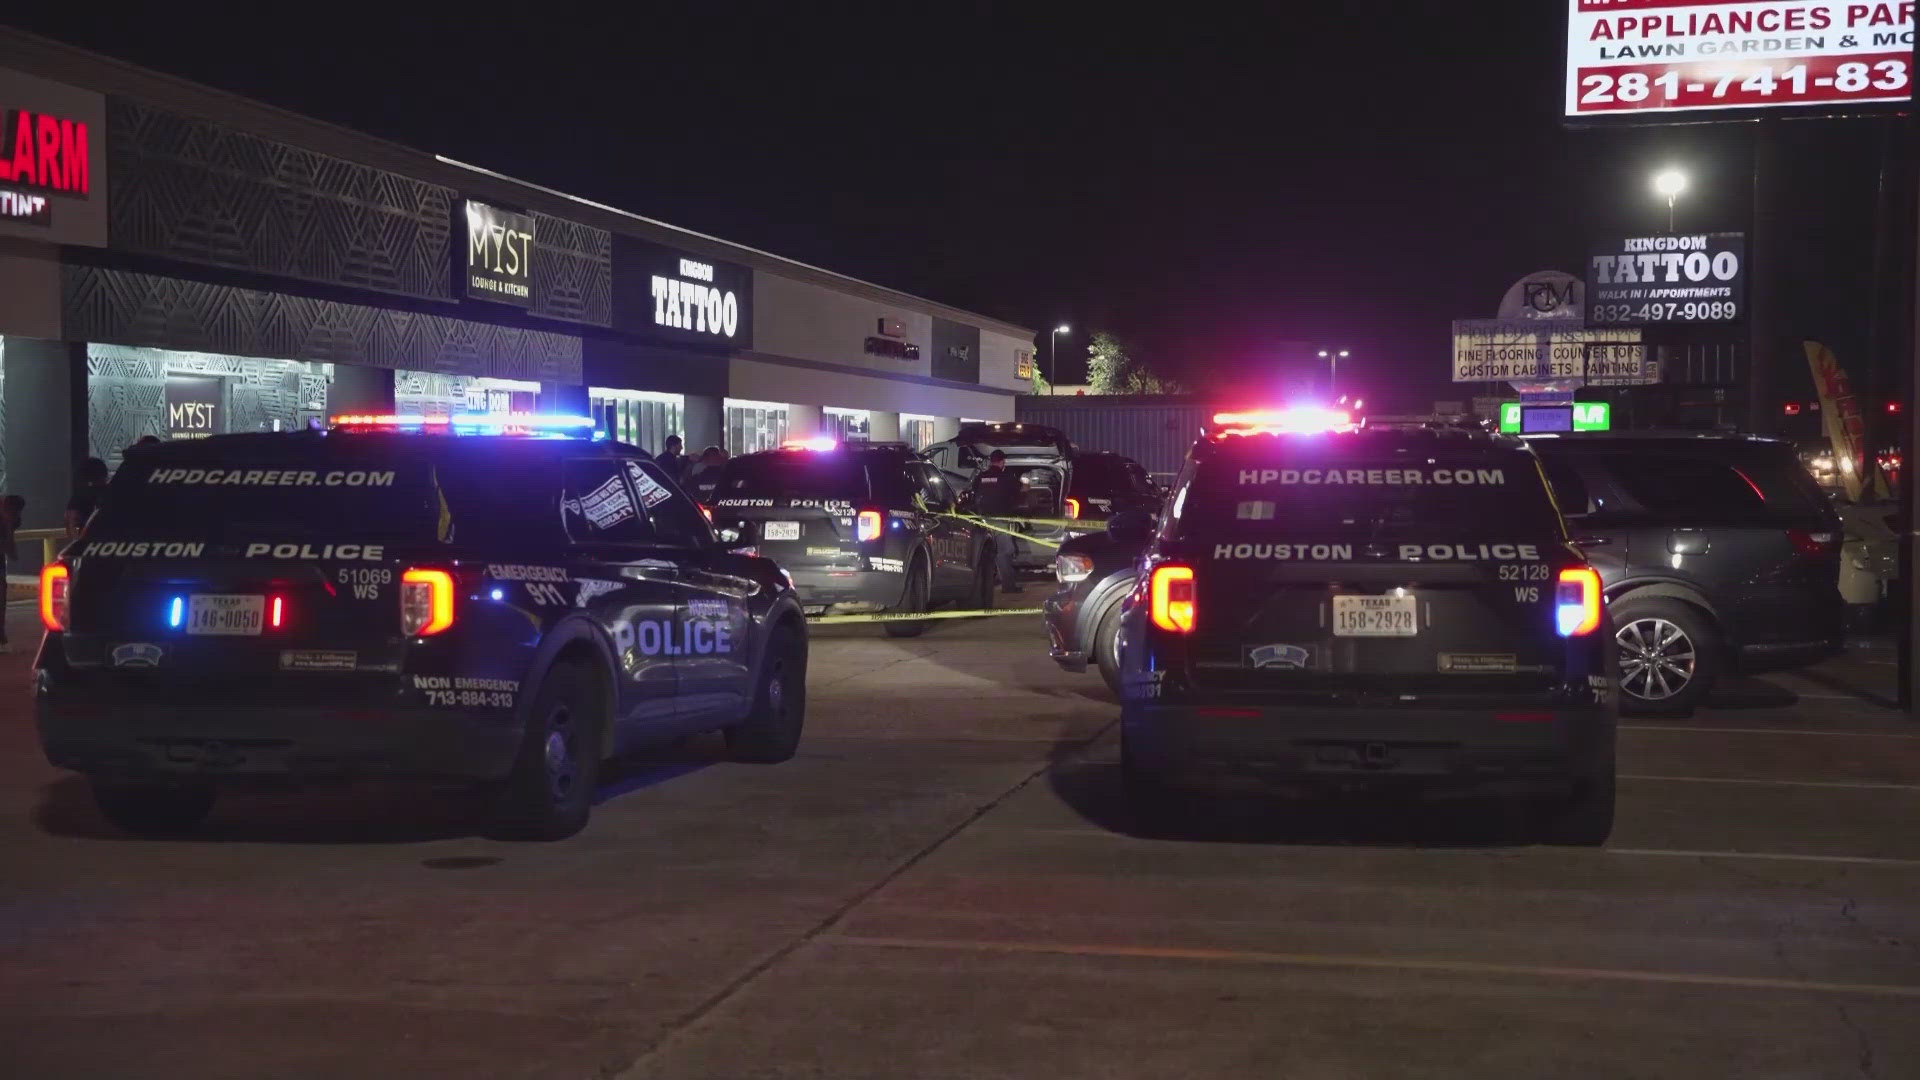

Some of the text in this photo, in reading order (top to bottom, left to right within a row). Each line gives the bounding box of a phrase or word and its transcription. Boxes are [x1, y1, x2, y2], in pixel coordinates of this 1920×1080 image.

[1589, 7, 1832, 41] APPLIANCES
[1600, 43, 1685, 60] LAWN
[1697, 36, 1825, 55] GARDEN
[1838, 34, 1859, 48] &
[0, 190, 46, 216] TINT
[469, 221, 533, 278] MYST
[1623, 235, 1707, 252] KINGDOM
[679, 258, 714, 282] KINGDOM
[1592, 251, 1739, 284] TATTOO
[472, 275, 497, 292] LOUNGE
[504, 282, 529, 298] KITCHEN
[1598, 290, 1628, 300] WALK
[1630, 289, 1643, 299] IN
[1649, 287, 1732, 299] APPOINTMENTS
[652, 275, 738, 338] TATTOO
[1593, 301, 1737, 322] 832-497-9089
[1457, 349, 1482, 361] FINE
[1486, 349, 1543, 361] FLOORING
[1460, 364, 1509, 377] CUSTOM
[1513, 363, 1572, 376] CABINETS
[169, 400, 216, 428] MYST
[149, 468, 395, 487] HPDCAREER.COM
[1238, 469, 1505, 485] HPDCAREER.COM
[717, 499, 774, 507] HOUSTON
[82, 542, 384, 561] HOUSTON POLICE
[1213, 544, 1541, 560] HOUSTON POLICE
[338, 569, 392, 584] 51069
[488, 563, 570, 582] EMERGENCY
[1499, 565, 1550, 581] 52128
[353, 585, 379, 600] WS
[525, 583, 568, 606] 911
[1515, 588, 1539, 602] WS
[1360, 599, 1391, 607] TEXAS
[612, 620, 731, 656] POLICE
[414, 674, 520, 692] NON EMERGENCY
